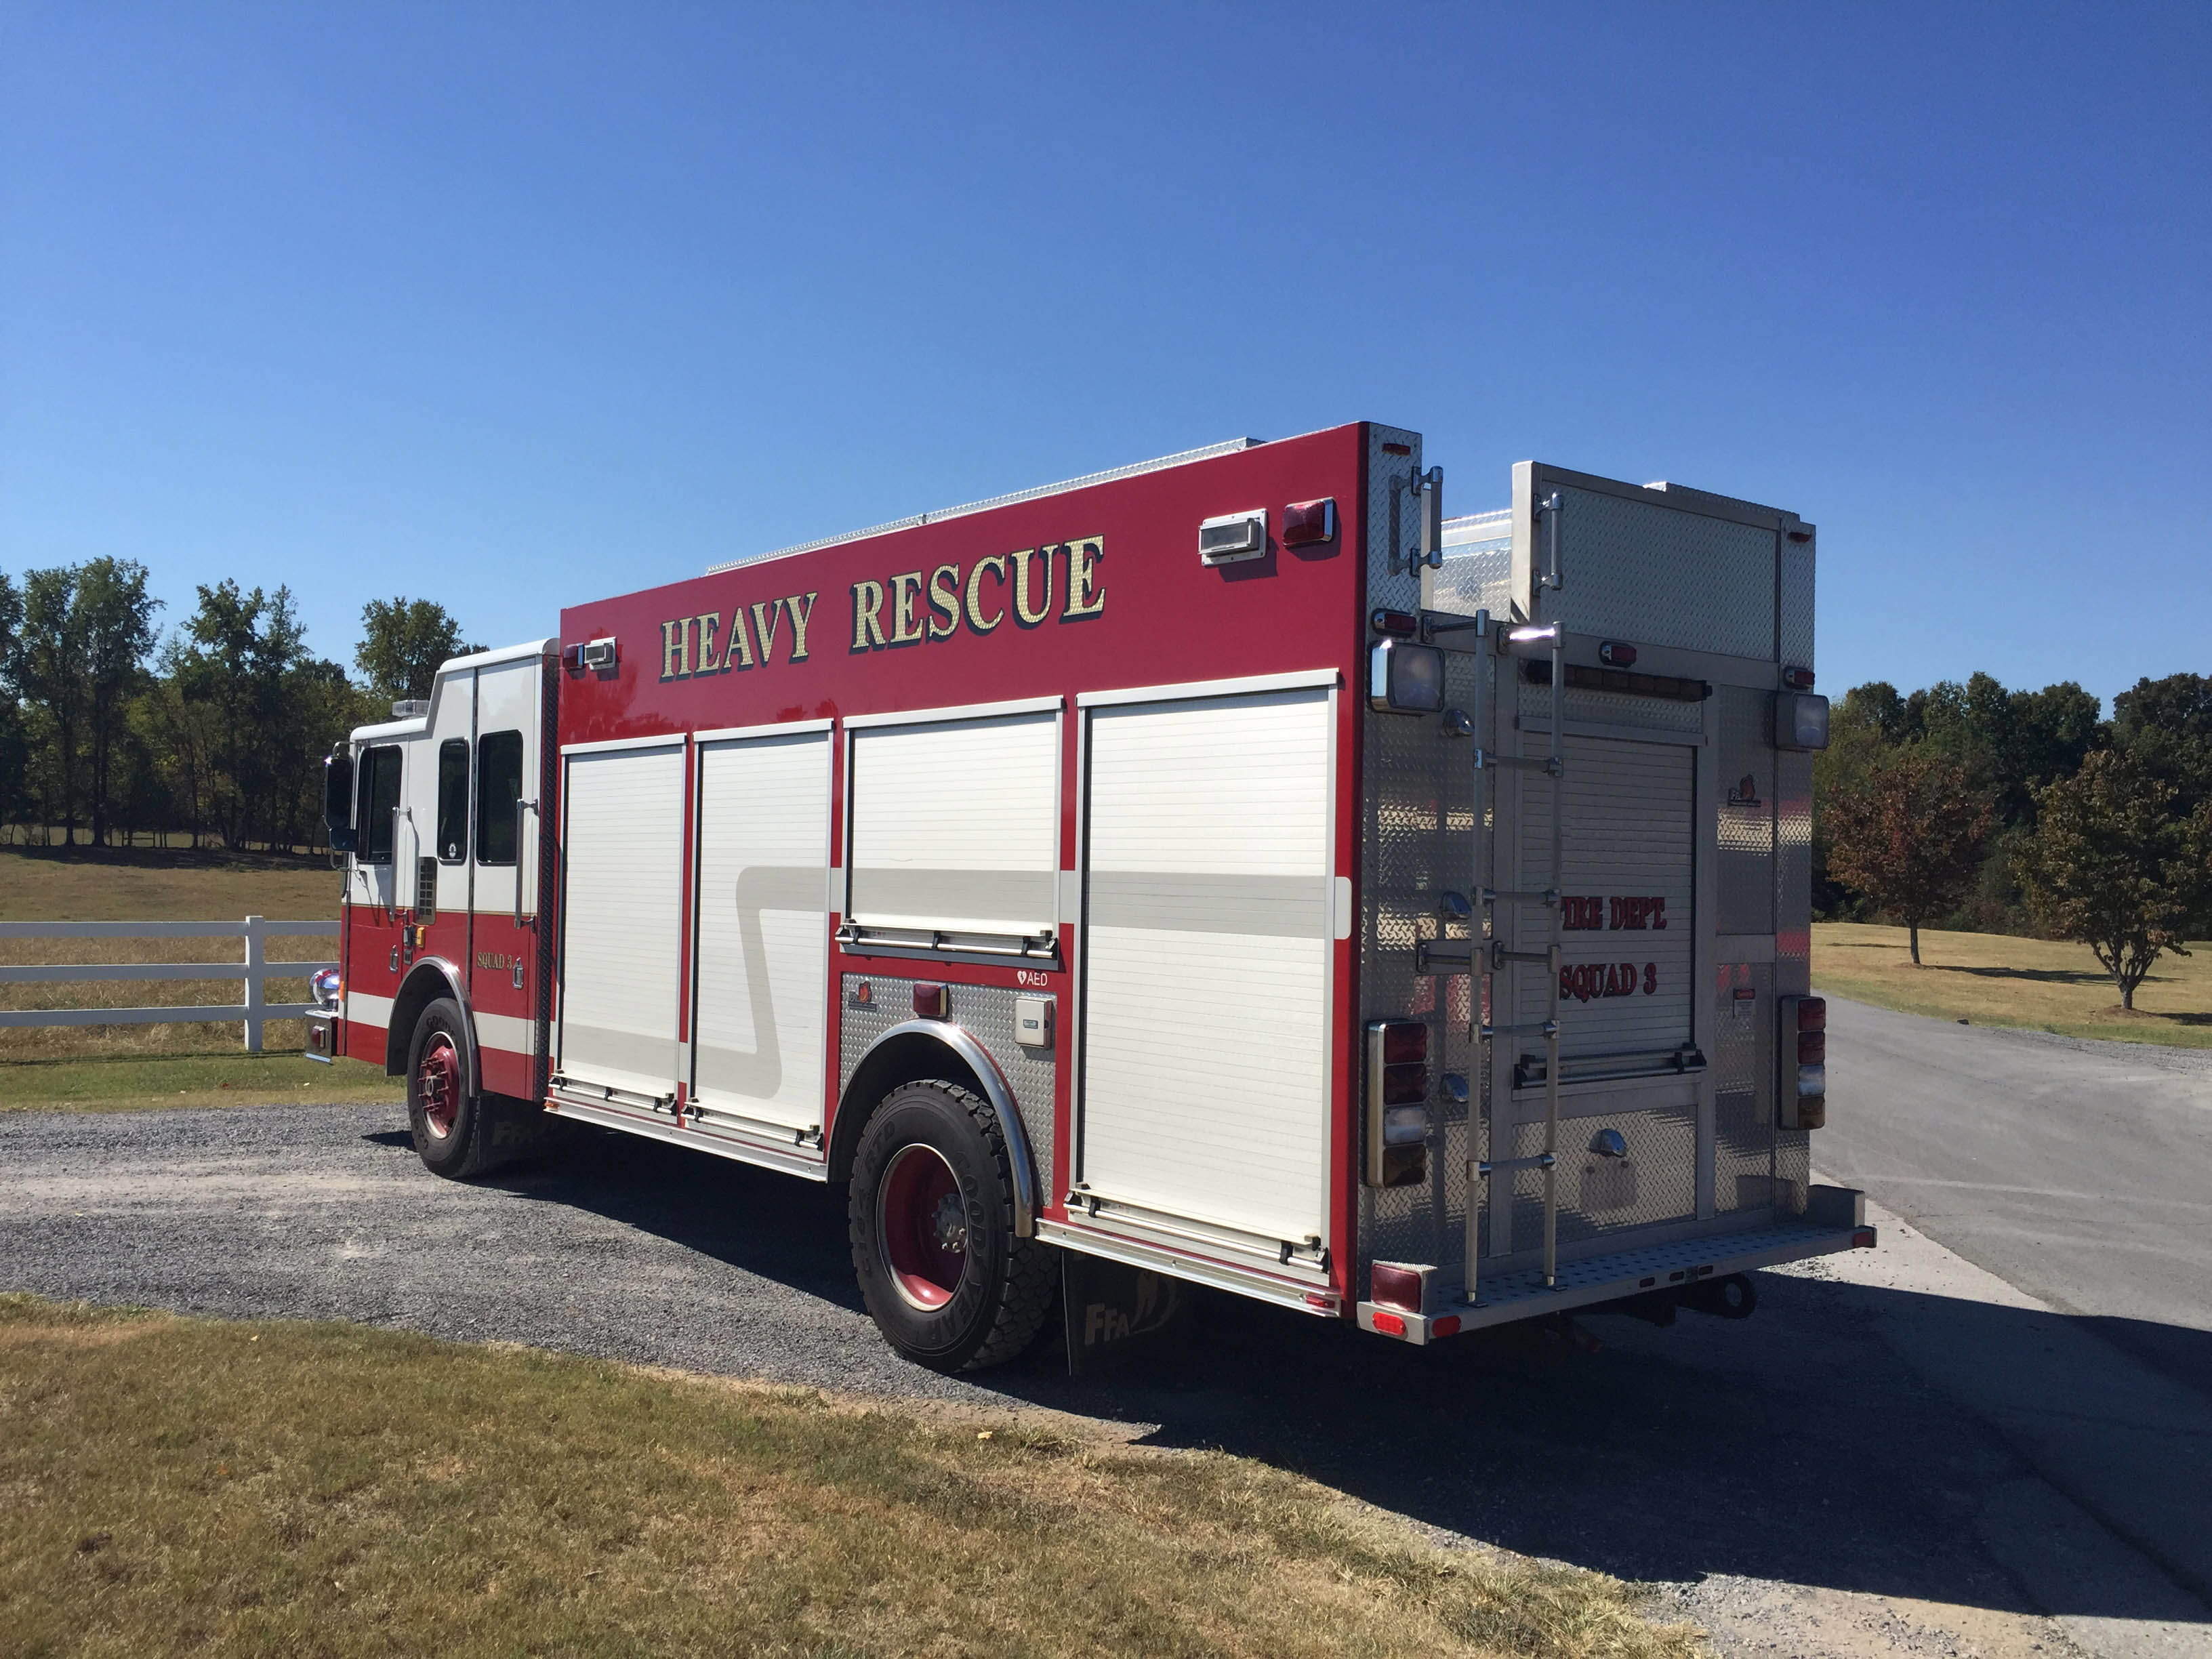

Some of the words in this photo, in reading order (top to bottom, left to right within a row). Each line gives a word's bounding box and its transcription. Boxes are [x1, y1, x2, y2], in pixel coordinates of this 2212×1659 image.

[659, 592, 818, 683] HEAVY
[848, 534, 1106, 655] RESCUE
[1561, 896, 1603, 930] IRE
[477, 951, 505, 970] SQUAD
[506, 954, 512, 970] 3
[1027, 972, 1048, 986] AED
[1559, 963, 1637, 1003] SQUAD
[1643, 962, 1657, 995] 3
[864, 1120, 895, 1174] RTD
[1084, 1302, 1129, 1346] FFA
